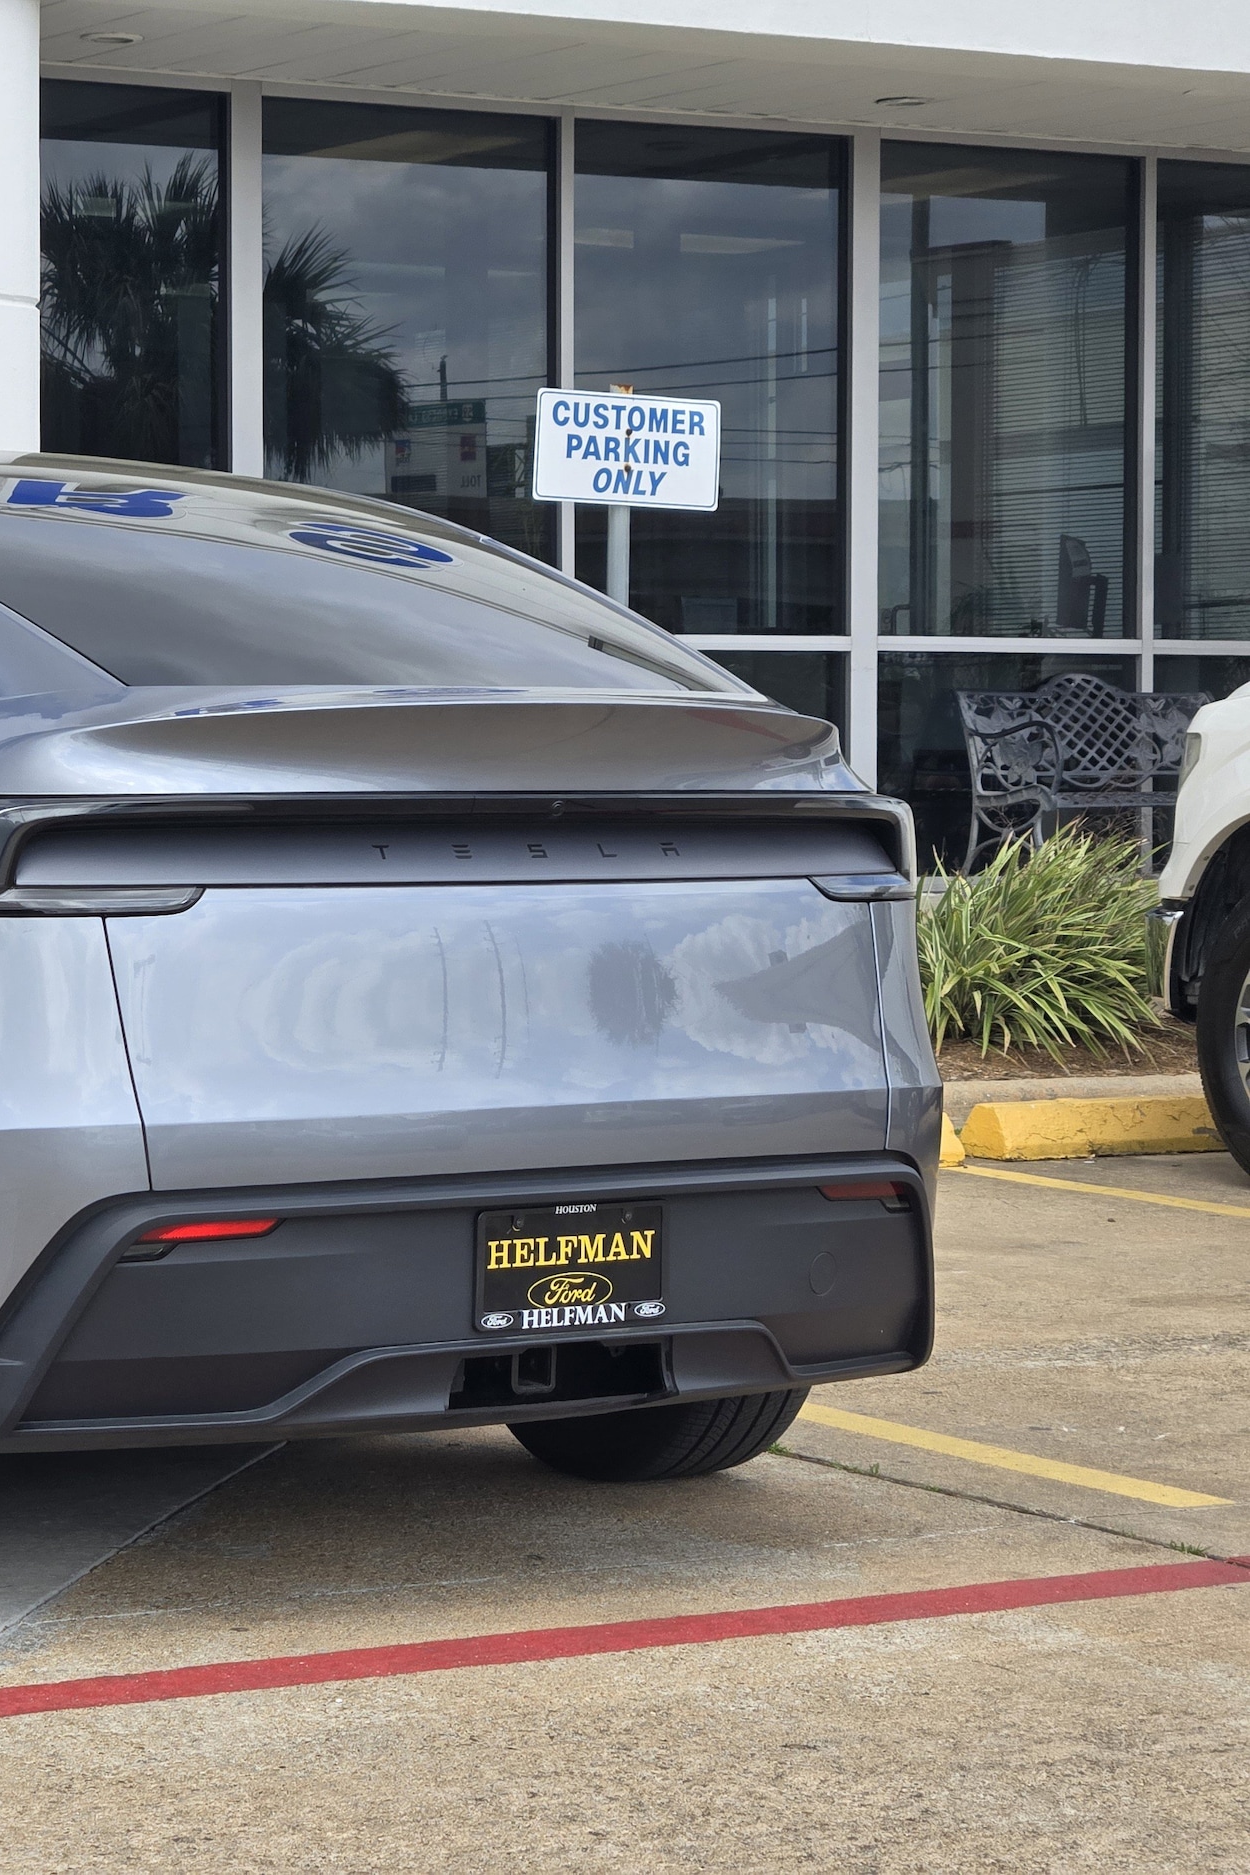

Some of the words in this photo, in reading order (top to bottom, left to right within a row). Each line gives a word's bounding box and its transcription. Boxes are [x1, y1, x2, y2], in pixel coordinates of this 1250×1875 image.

[552, 400, 705, 436] CUSTOMER
[566, 433, 690, 466] PARKING
[593, 467, 667, 496] ONLY
[372, 842, 680, 860] TESLA
[555, 1204, 597, 1214] HOUSTON
[487, 1230, 655, 1269] HELFMAN
[544, 1277, 597, 1304] Ford
[522, 1303, 626, 1329] HELFMAN
